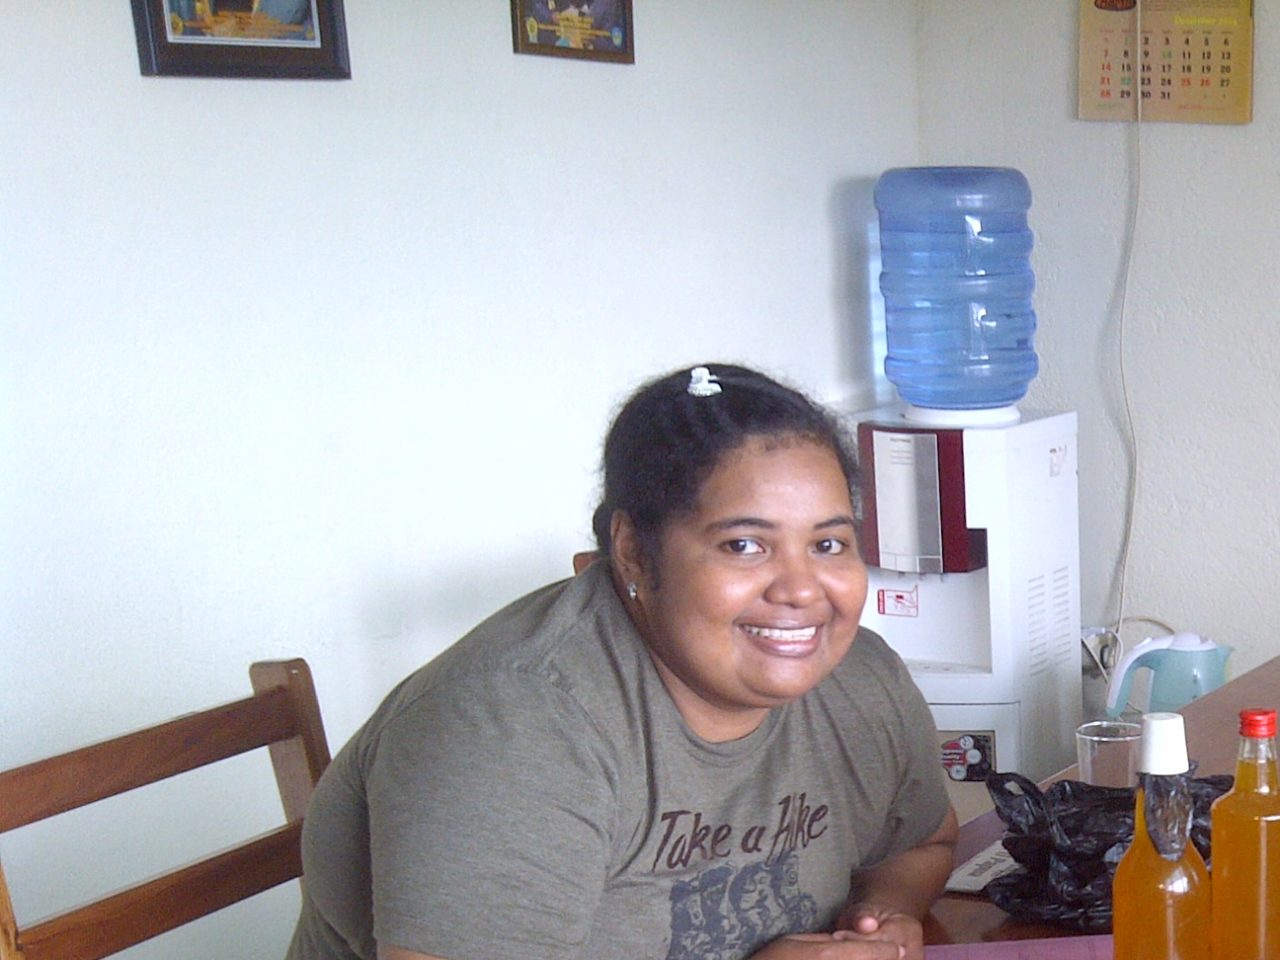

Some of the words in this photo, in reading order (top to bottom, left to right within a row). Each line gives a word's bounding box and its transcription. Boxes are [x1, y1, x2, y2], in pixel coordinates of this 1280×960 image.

[1182, 51, 1191, 60] 11
[1202, 51, 1212, 60] 12
[1221, 51, 1231, 60] 13
[1101, 63, 1112, 71] 14
[1122, 63, 1132, 72] 15
[1141, 64, 1152, 73] 16
[1162, 64, 1172, 73] 17
[1182, 65, 1192, 73] 18
[1201, 65, 1212, 74] 19
[1220, 65, 1231, 74] 20
[1100, 76, 1110, 85] 21
[1141, 77, 1152, 86] 23
[1160, 78, 1172, 86] 24
[1200, 78, 1212, 87] 26
[1220, 78, 1231, 87] 27
[1100, 89, 1112, 98] 28
[1120, 89, 1132, 98] 29
[1141, 90, 1152, 99] 30
[1160, 91, 1171, 100] 31
[652, 810, 732, 873] Take
[740, 825, 766, 853] a
[764, 792, 829, 866] Hike
